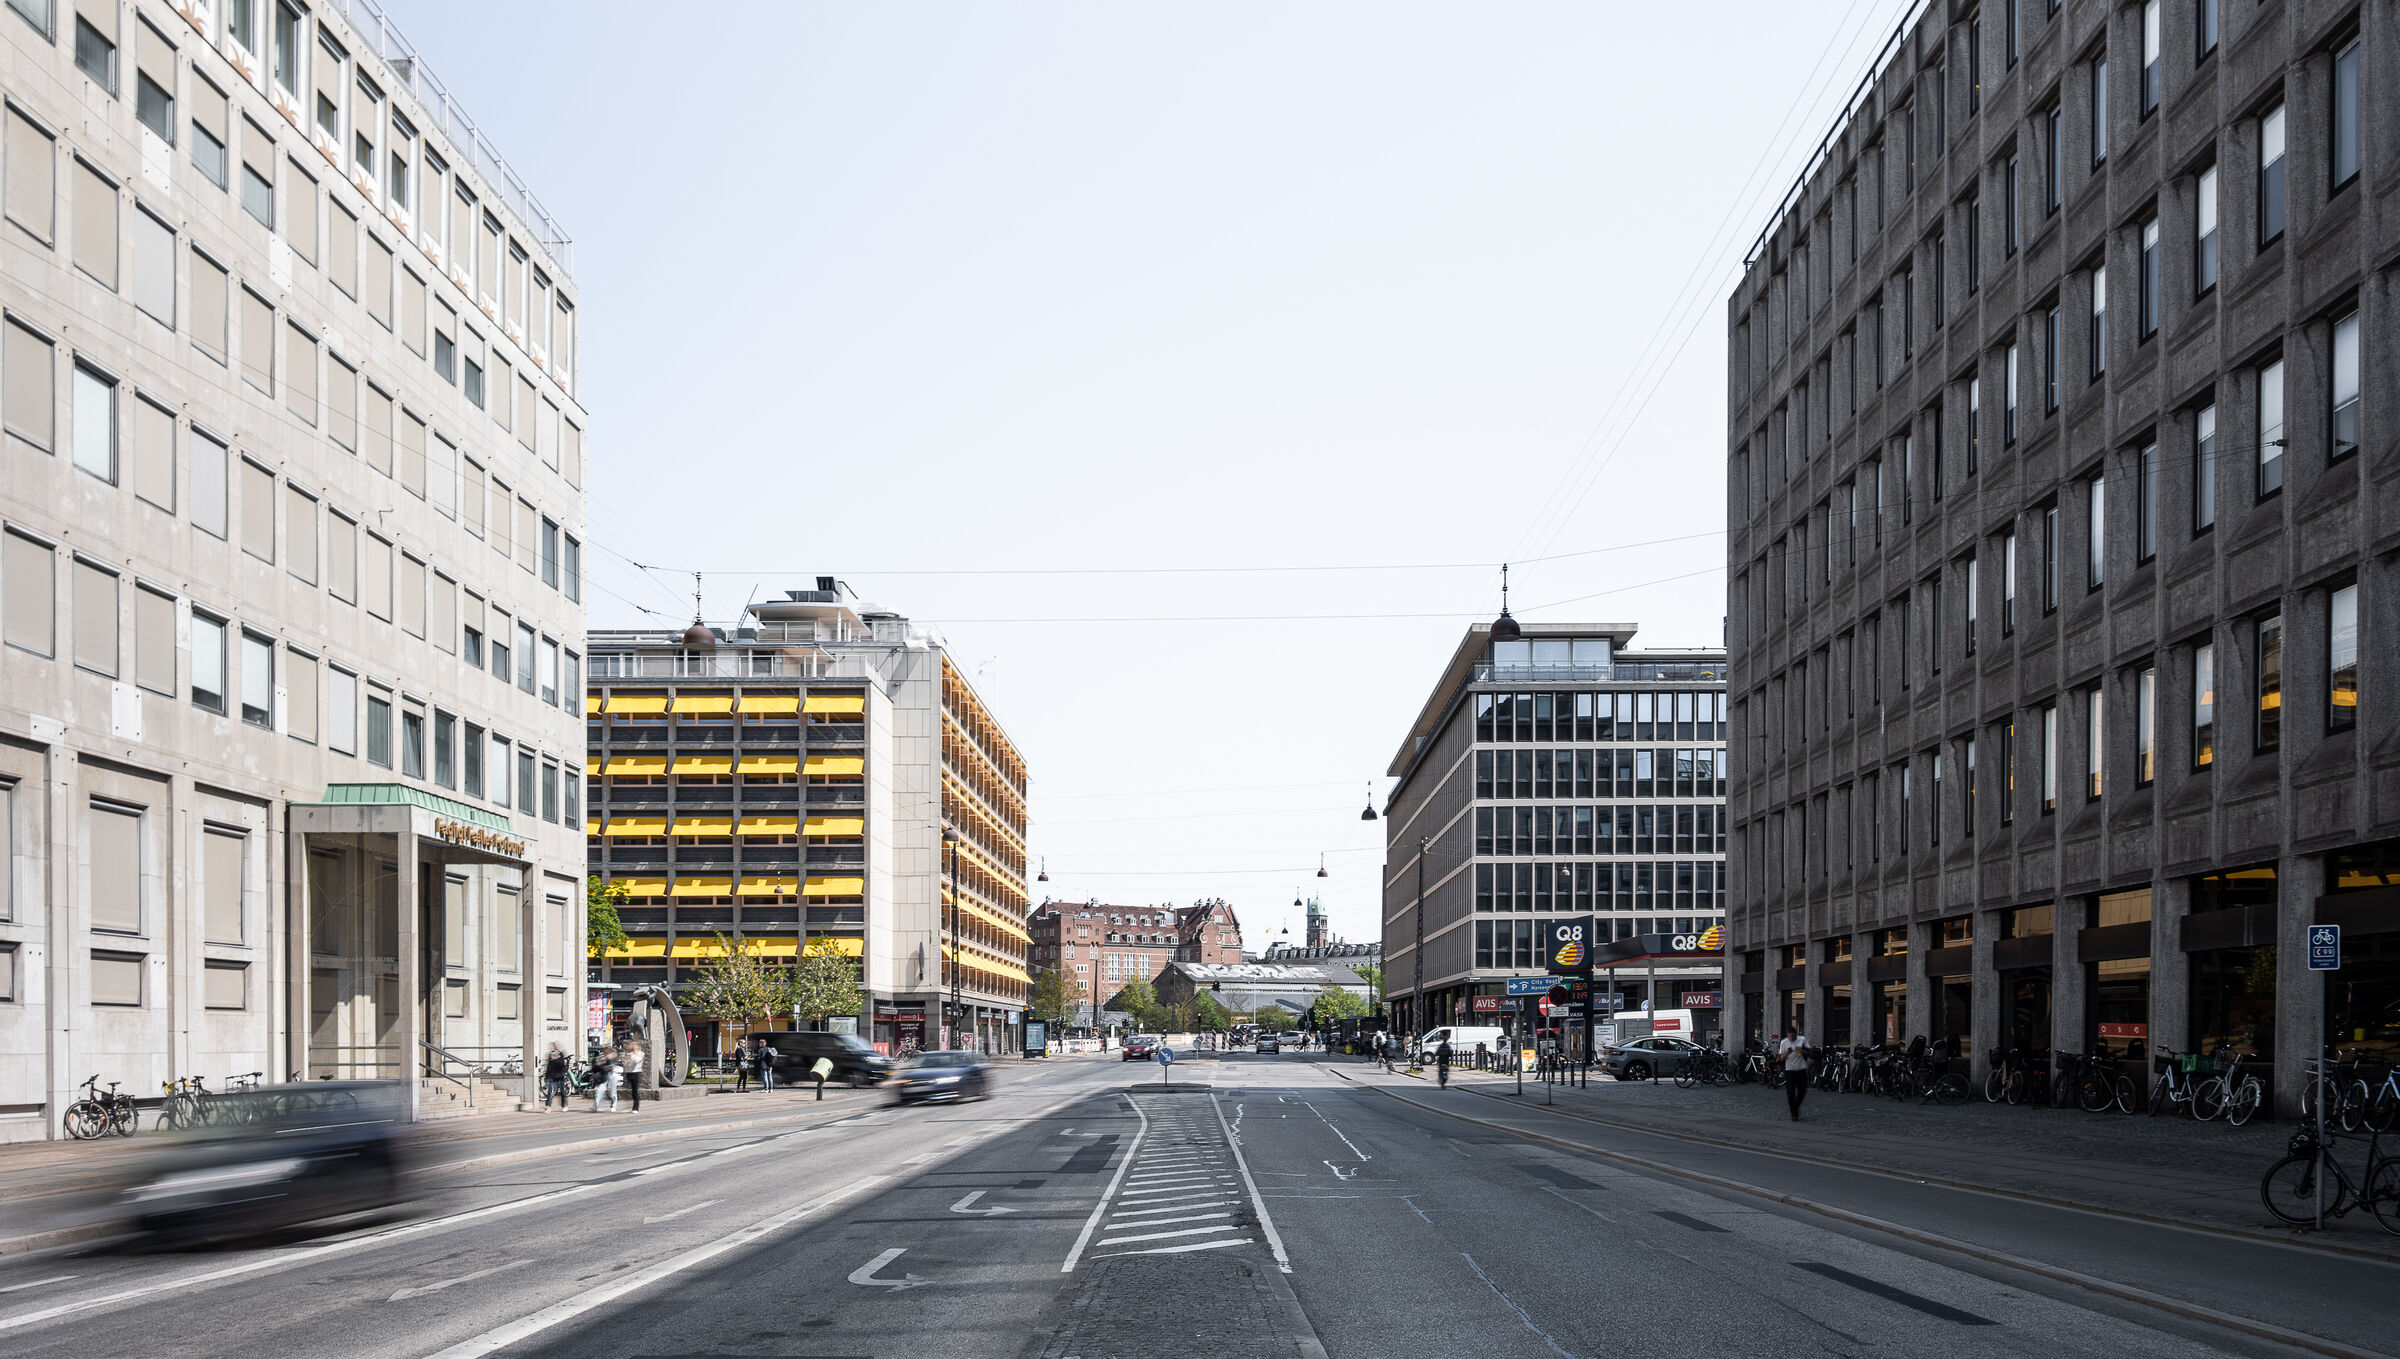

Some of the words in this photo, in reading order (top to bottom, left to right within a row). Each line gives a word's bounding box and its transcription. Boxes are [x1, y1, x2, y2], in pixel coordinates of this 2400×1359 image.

[1556, 925, 1583, 942] Q8
[1671, 935, 1697, 951] Q8
[1475, 999, 1496, 1008] AVIS
[1685, 996, 1711, 1005] AVIS
